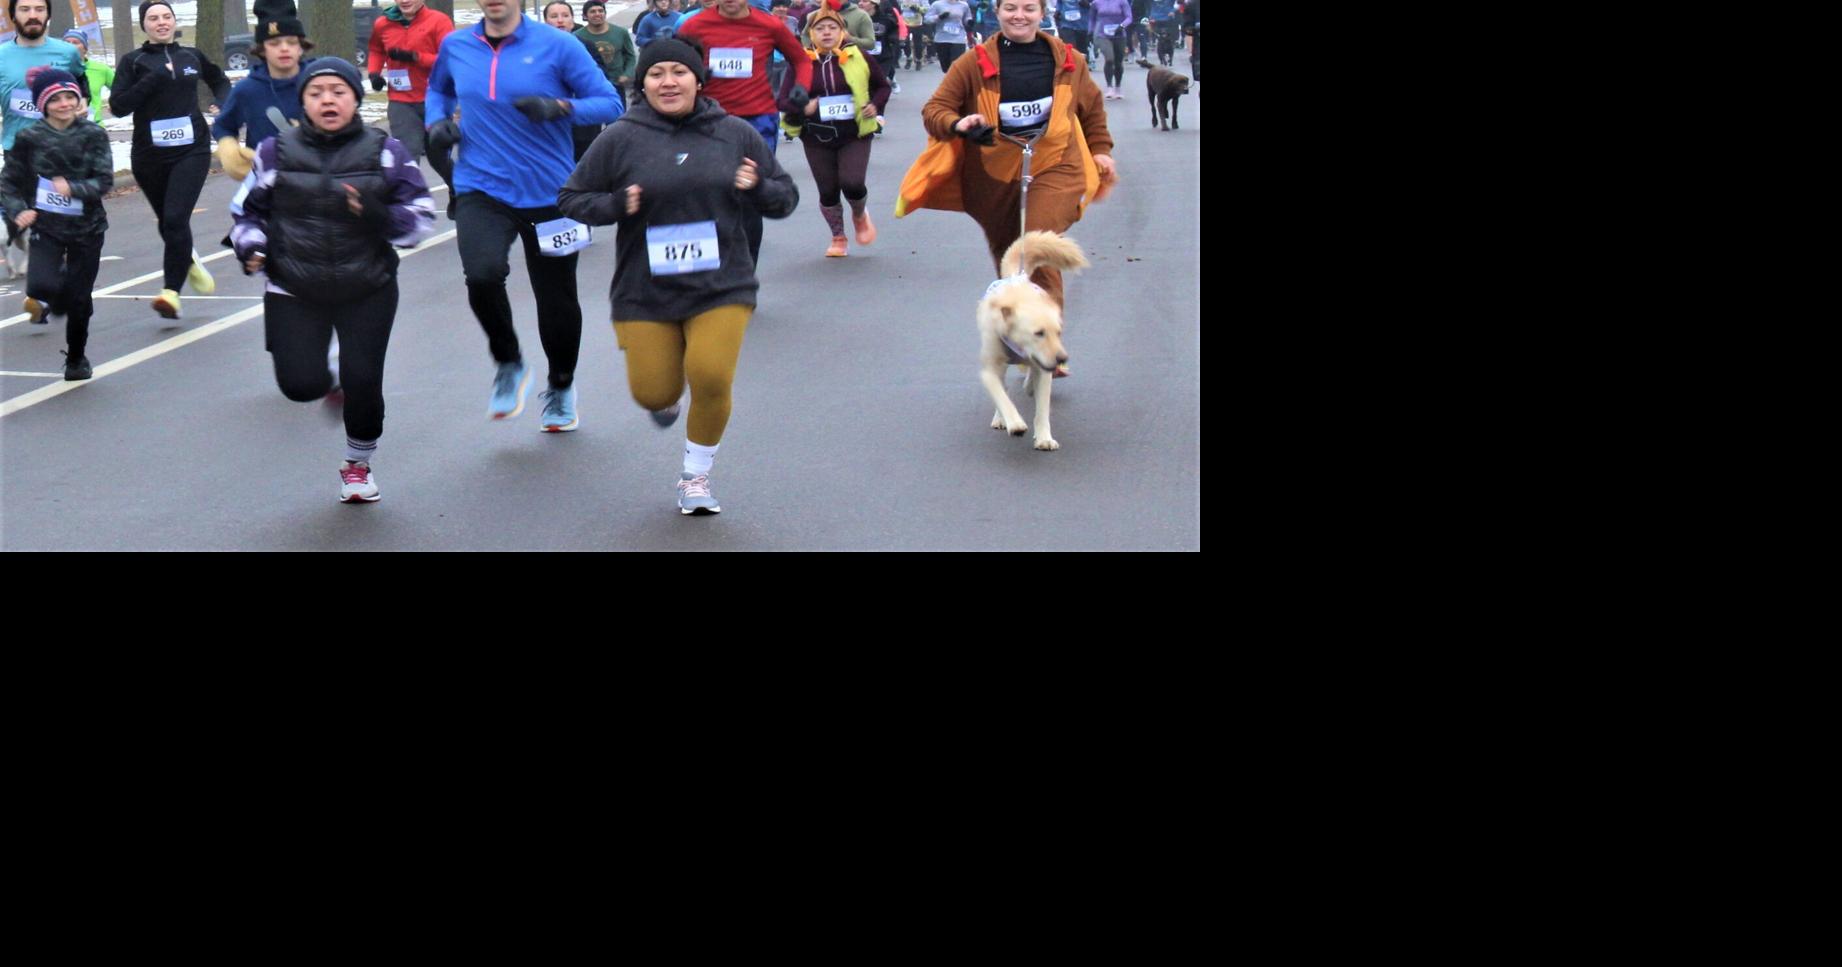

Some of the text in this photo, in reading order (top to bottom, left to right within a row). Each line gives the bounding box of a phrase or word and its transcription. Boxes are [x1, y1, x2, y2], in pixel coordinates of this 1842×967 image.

[719, 59, 743, 71] 648
[828, 104, 848, 115] 874
[1011, 103, 1042, 118] 598
[162, 129, 184, 141] 269
[47, 193, 71, 207] 859
[552, 229, 579, 249] 832
[665, 242, 703, 261] 875
